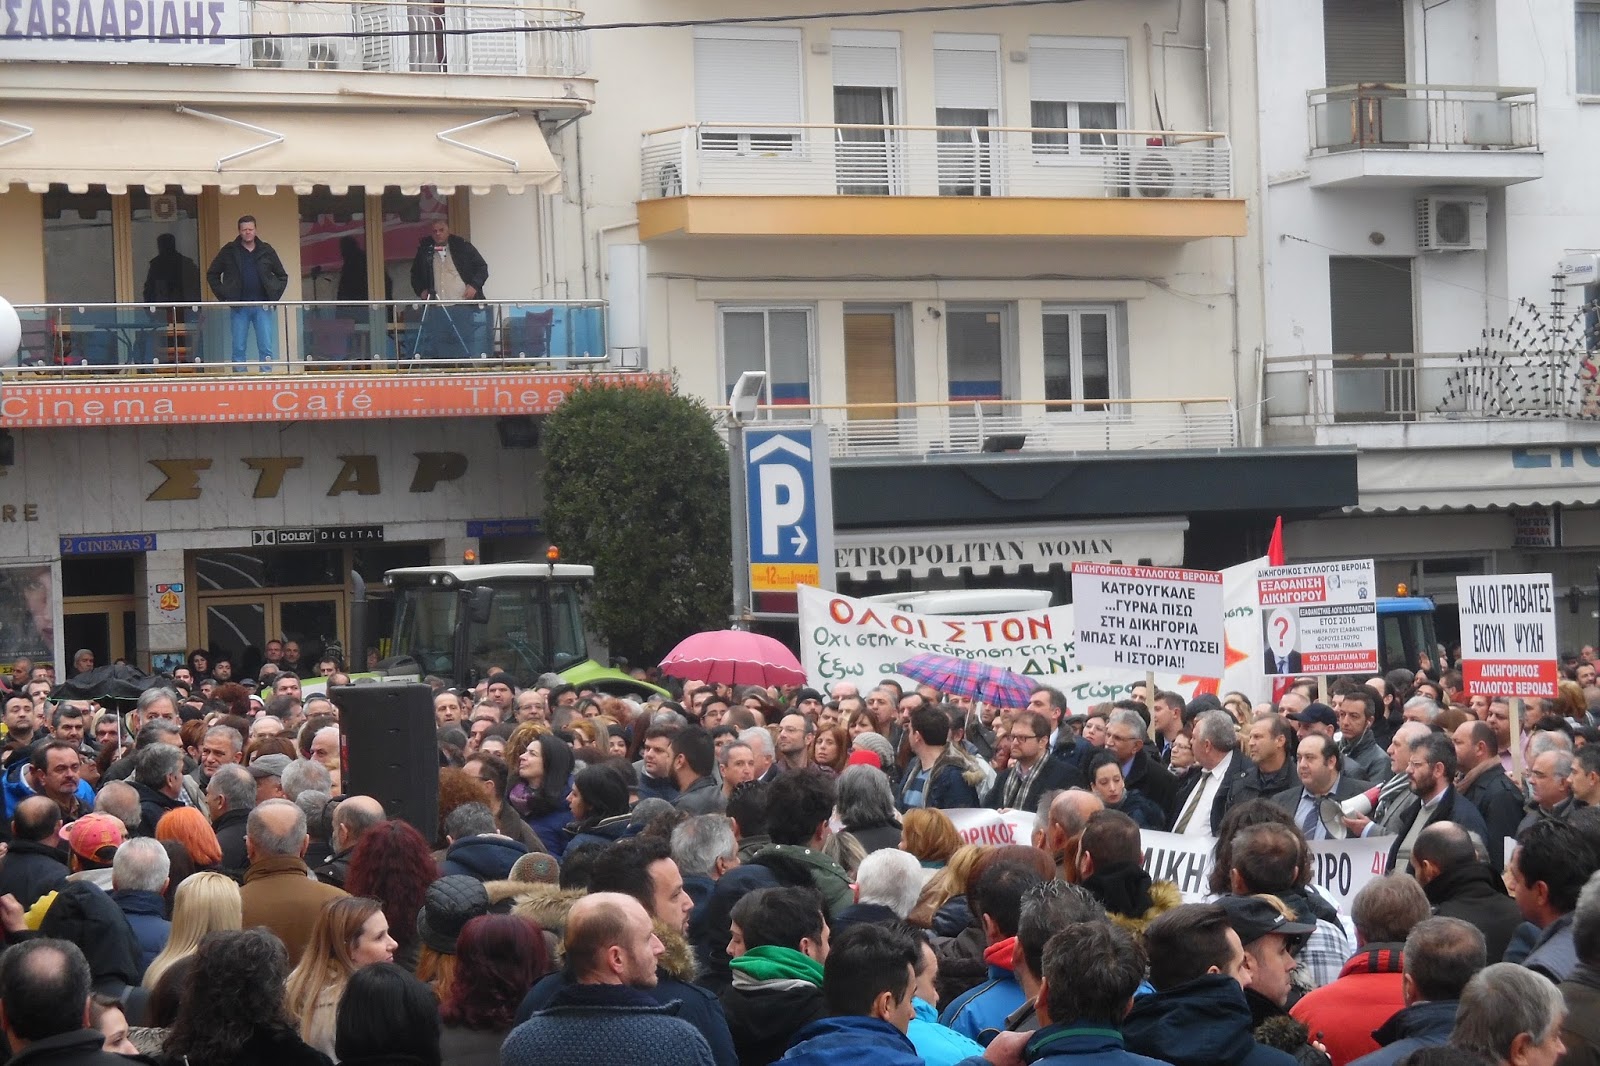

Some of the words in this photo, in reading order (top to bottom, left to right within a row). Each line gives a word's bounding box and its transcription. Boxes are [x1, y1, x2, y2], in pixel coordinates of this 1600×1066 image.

[0, 0, 225, 44] ΣΑΒΔΑΡΙΔΗΣ
[1, 396, 174, 418] Cinema
[272, 389, 372, 412] Café
[464, 386, 564, 406] Thea
[146, 452, 468, 501] ΣΤΑΡ
[759, 463, 805, 555] P
[64, 538, 73, 553] 2
[78, 539, 140, 554] CINEMAS
[143, 536, 153, 550] 2
[280, 532, 312, 541] DOLBY
[321, 530, 382, 539] DIGITAL
[834, 541, 1025, 568] ETROPOLITAN
[1038, 538, 1113, 557] WOMAN
[766, 566, 776, 585] 12
[1074, 563, 1132, 576] ΔΙΚΗΓΟΡΙΚΟΣ
[1134, 568, 1180, 580] ΣΥΛΛΟΓΟΣ
[1183, 571, 1220, 583] ΒΕΡΟΙΑΣ
[1258, 566, 1302, 578] ΔΙΚΗΓΟΡΙΚΟΣ
[1303, 563, 1339, 574] ΣΥΛΛΟΓΟΣ
[1341, 561, 1371, 571] ΒΕΡΟΙΑΣ
[1101, 581, 1195, 600] ΚΑΤΡΟΥΓΚΑΛΕ
[1260, 577, 1322, 592] ΕΞΑΦΑΝΙΣΗ
[1261, 590, 1323, 604] ΔΙΚΗΓΟΡΟΥ
[1488, 584, 1500, 614] ΟΙ
[1501, 583, 1551, 614] ΓΡΑΒΑΤΕΣ
[1105, 599, 1157, 614] ...ΓΥΡΝΑ
[1162, 603, 1193, 617] ΠΙΣΩ
[829, 598, 928, 639] ΟΛΟΙ
[942, 614, 1052, 644] ΣΤΟΝ
[1100, 616, 1125, 628] ΣΤΗ
[1129, 618, 1198, 635] ΔΙΚΗΓΟΡΙΑ
[1320, 617, 1337, 625] ΕΤΟΣ
[1339, 616, 1356, 624] 2016
[813, 626, 851, 647] Οχι
[1015, 643, 1058, 657] της
[1080, 631, 1116, 645] ΜΠΑΣ
[1120, 635, 1141, 647] ΚΑΙ
[1146, 637, 1219, 654] ...ΓΛΥΤΩΣΕΙ
[1473, 623, 1506, 653] ΕΧΟΥΝ
[1514, 623, 1544, 653] ΨΥΧΗ
[1114, 651, 1123, 662] Η
[1128, 651, 1185, 668] ΙΣΤΟΡΙΑ!!
[1481, 664, 1540, 678] ΔΙΚΗΓΟΡΙΚΟΣ
[1469, 681, 1514, 694] ΣΥΛΛΟΓΟΣ
[1515, 682, 1554, 695] ΒΕΡΟΙΑΣ
[960, 823, 1018, 845] ΟΡΙΚΟΣ
[1309, 852, 1351, 896] ΙΡΟ
